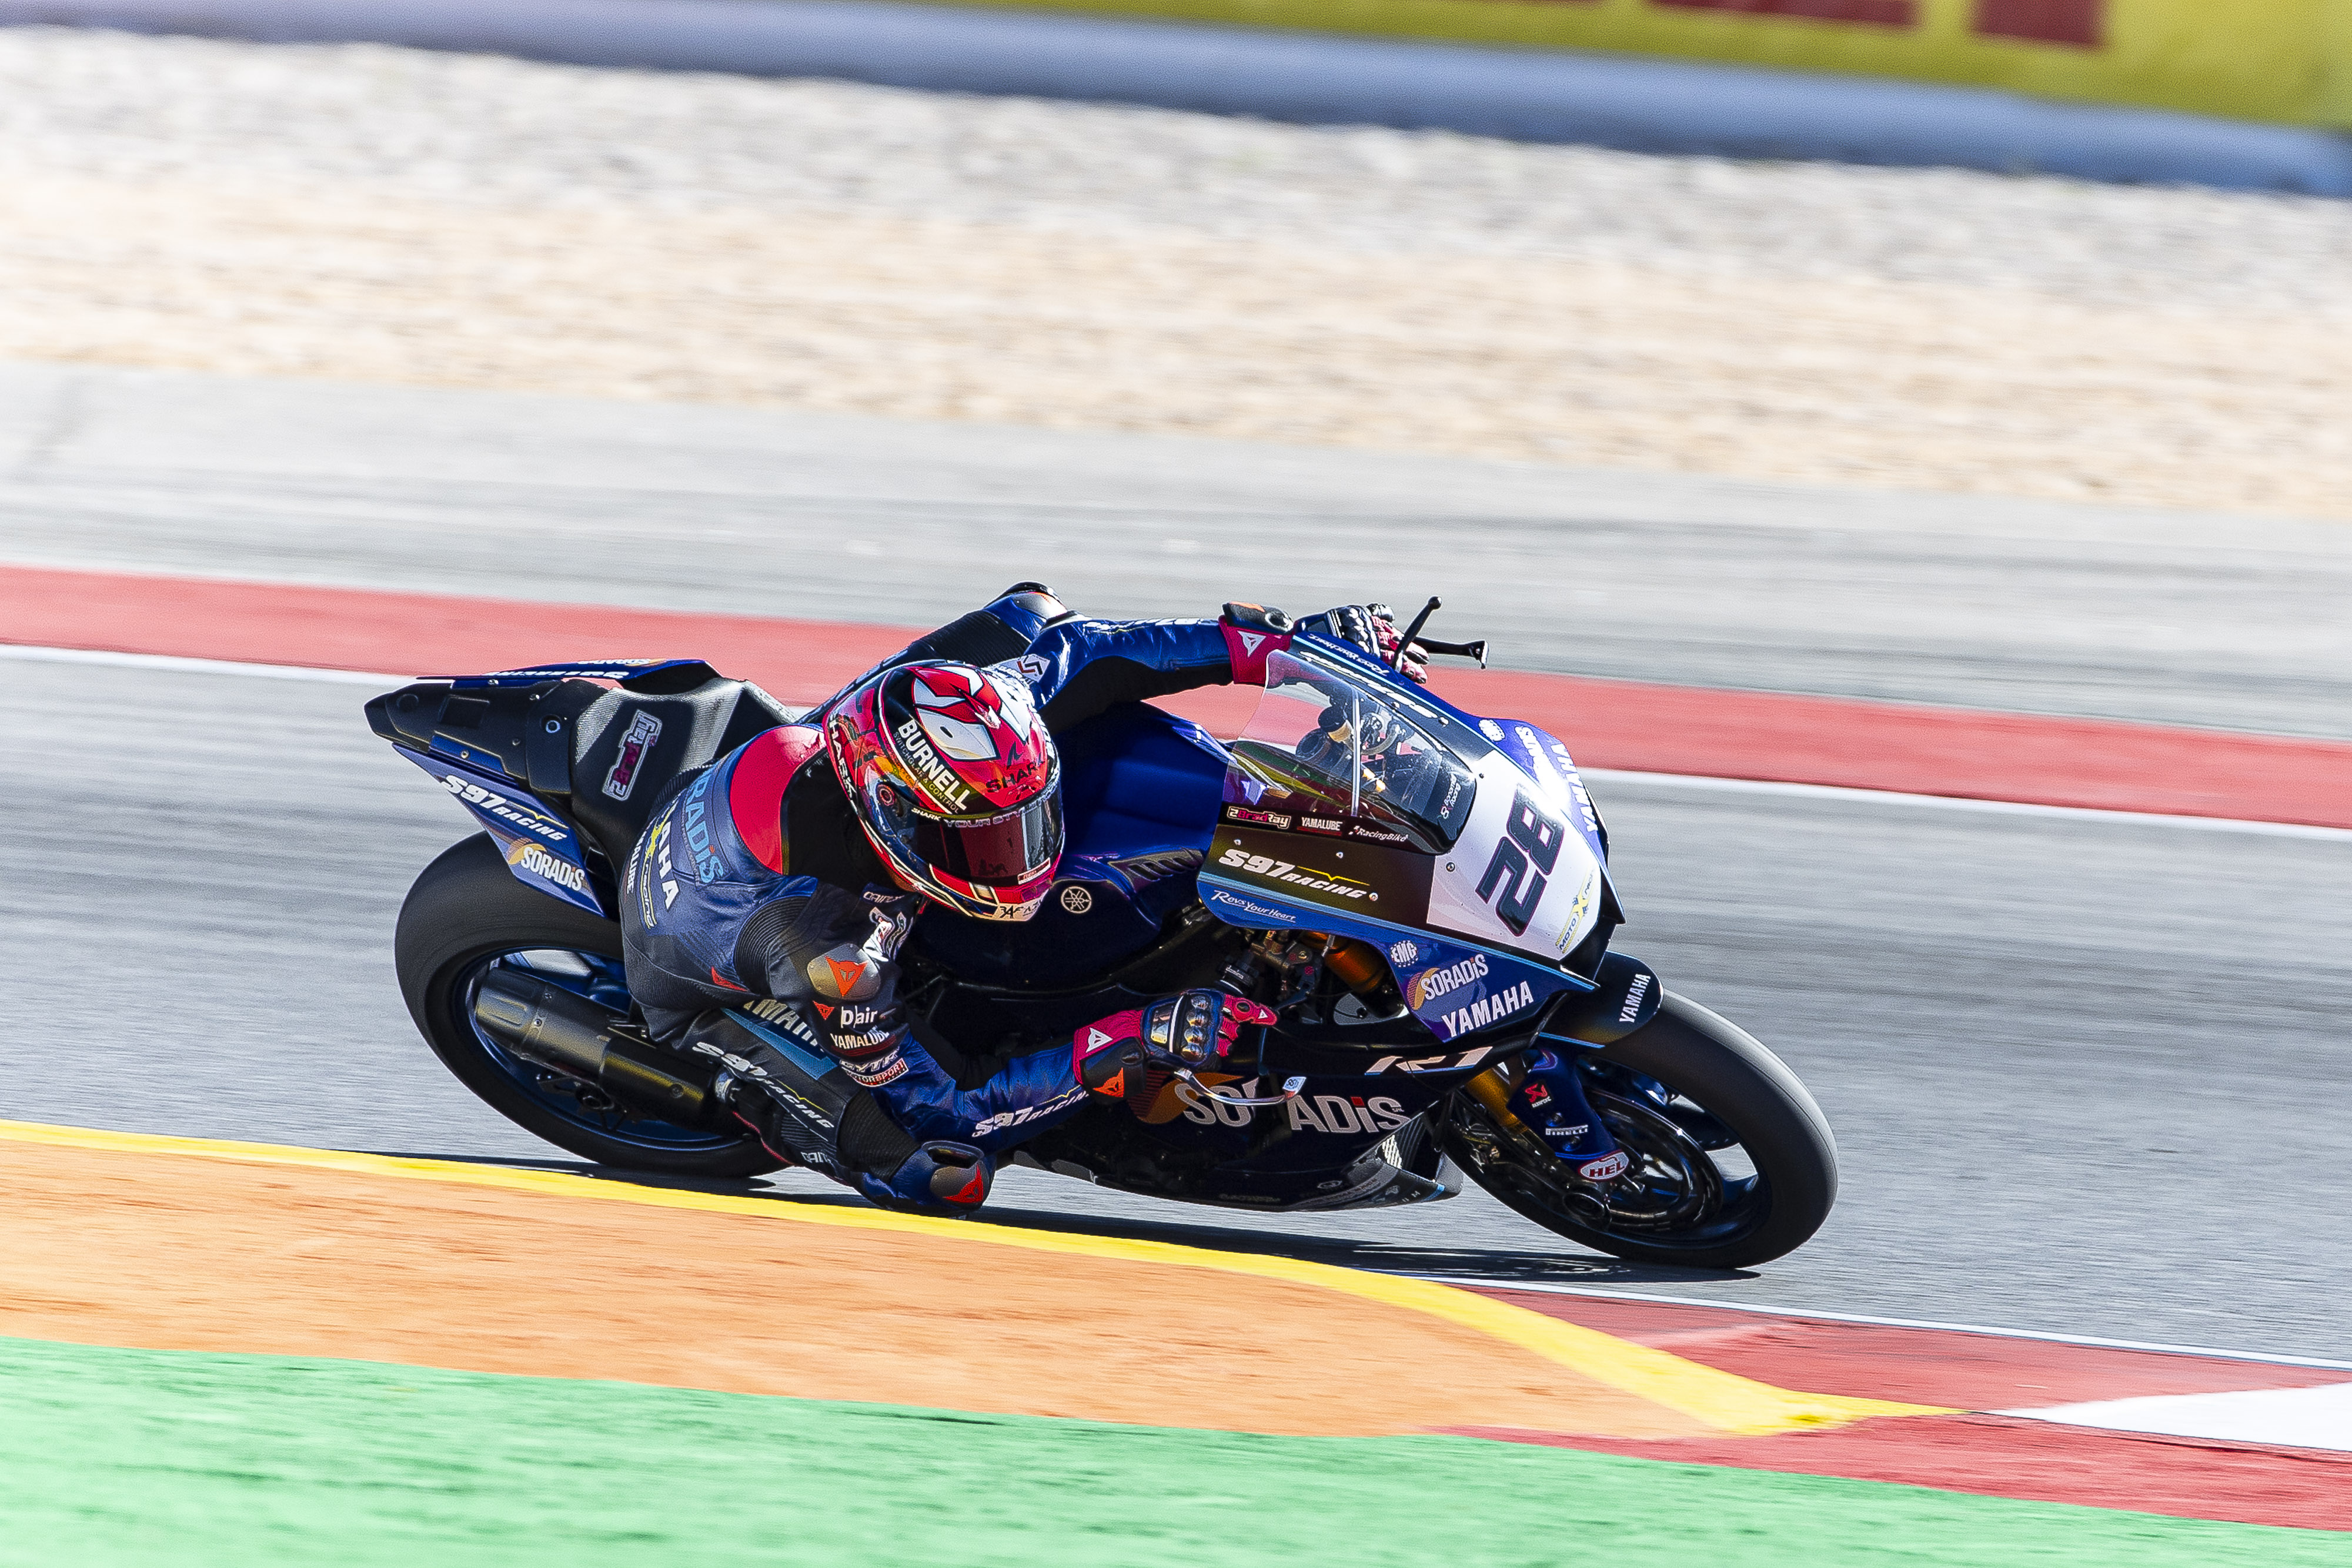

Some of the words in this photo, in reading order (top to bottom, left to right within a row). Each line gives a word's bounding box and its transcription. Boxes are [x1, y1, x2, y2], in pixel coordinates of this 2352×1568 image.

[898, 719, 970, 811] BURNELL
[928, 783, 959, 814] CONTROL
[911, 808, 941, 821] SHARK
[1301, 817, 1343, 831] YAMALUBE
[1475, 783, 1565, 937] 28
[1390, 941, 1418, 965] EMG
[1441, 980, 1534, 1038] YAMAHA
[1619, 973, 1651, 1023] YAMAHA
[1545, 1124, 1589, 1136] PIRELLI
[1589, 1161, 1625, 1178] HEL
